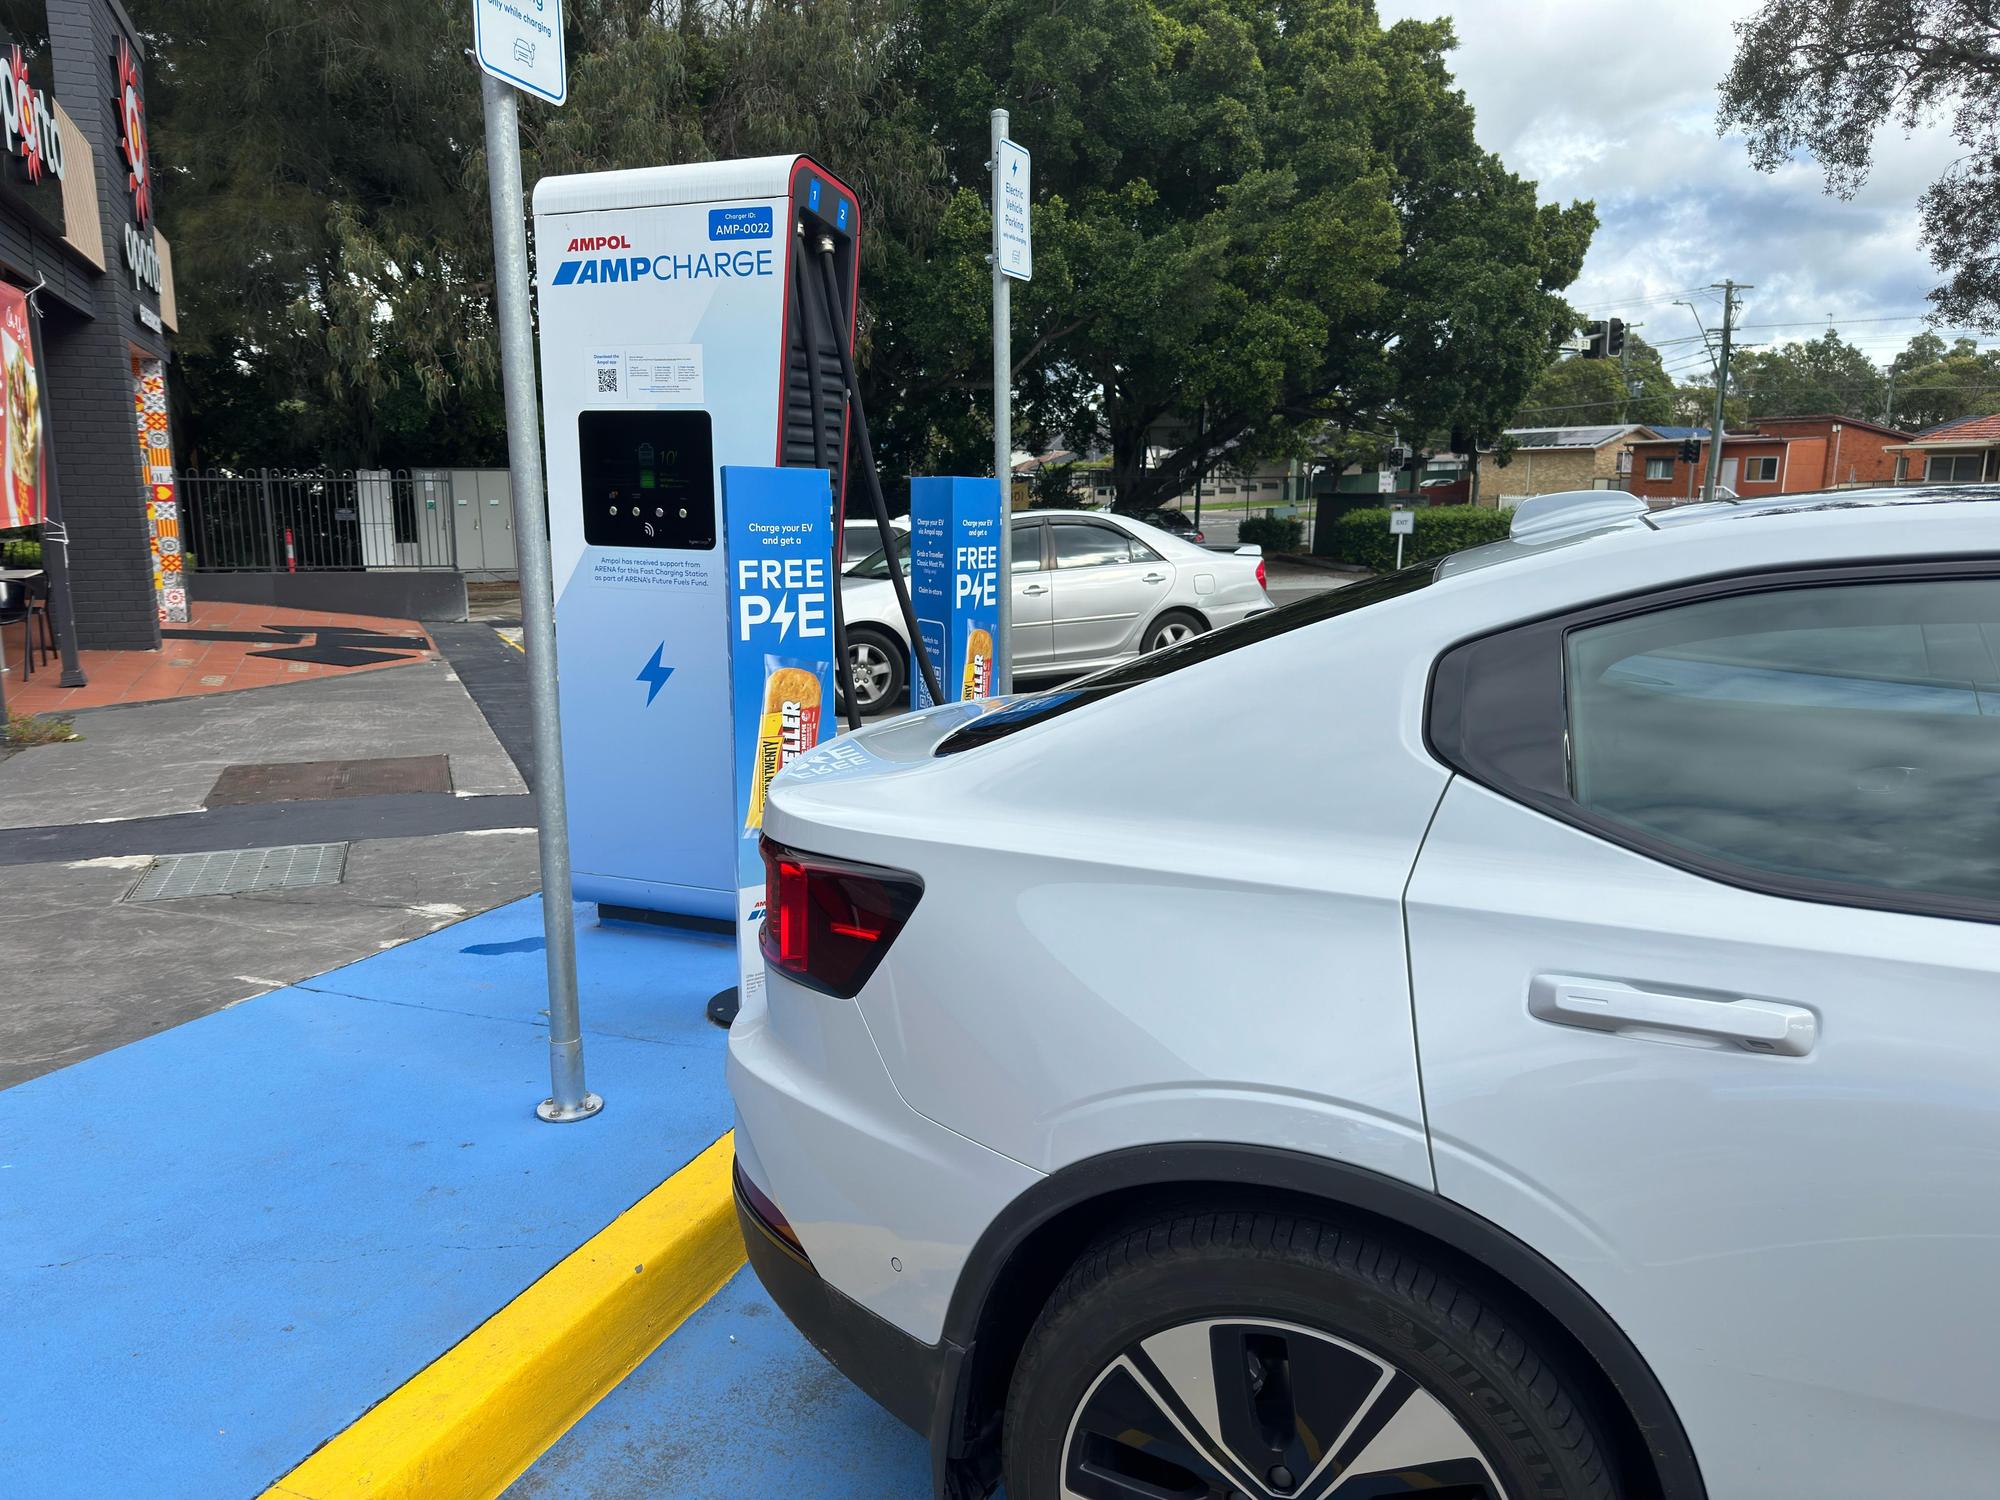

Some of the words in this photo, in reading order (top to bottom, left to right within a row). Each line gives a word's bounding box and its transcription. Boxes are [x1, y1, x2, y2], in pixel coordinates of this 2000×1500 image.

[504, 4, 522, 20] while
[523, 14, 552, 38] charging
[0, 58, 64, 181] porto
[813, 190, 817, 201] 1
[1006, 182, 1023, 200] Electric
[1006, 199, 1023, 215] Vehicle
[724, 212, 747, 221] Charger
[840, 209, 845, 220] 2
[716, 223, 770, 236] AMP-0022
[1005, 214, 1024, 233] Parking
[567, 235, 631, 252] AMPOL
[576, 249, 773, 285] AMPCHARGE
[748, 523, 780, 534] Charge
[781, 525, 800, 534] your
[801, 523, 813, 532] EV
[917, 518, 929, 527] Charge
[962, 519, 977, 528] Charge
[924, 528, 935, 536] Ampol
[762, 536, 779, 545] and
[780, 537, 794, 546] get
[601, 557, 620, 565] Ampol
[660, 560, 683, 568] support
[956, 546, 997, 570] FREE
[655, 568, 683, 577] Charging
[684, 569, 708, 577] Station
[738, 559, 824, 590] FREE
[625, 576, 651, 584] ARENA's
[652, 577, 672, 585] Future
[674, 578, 690, 586] Fuels
[691, 579, 709, 587] Fund.
[782, 700, 800, 764] ELLER
[763, 741, 779, 776] TWENTY
